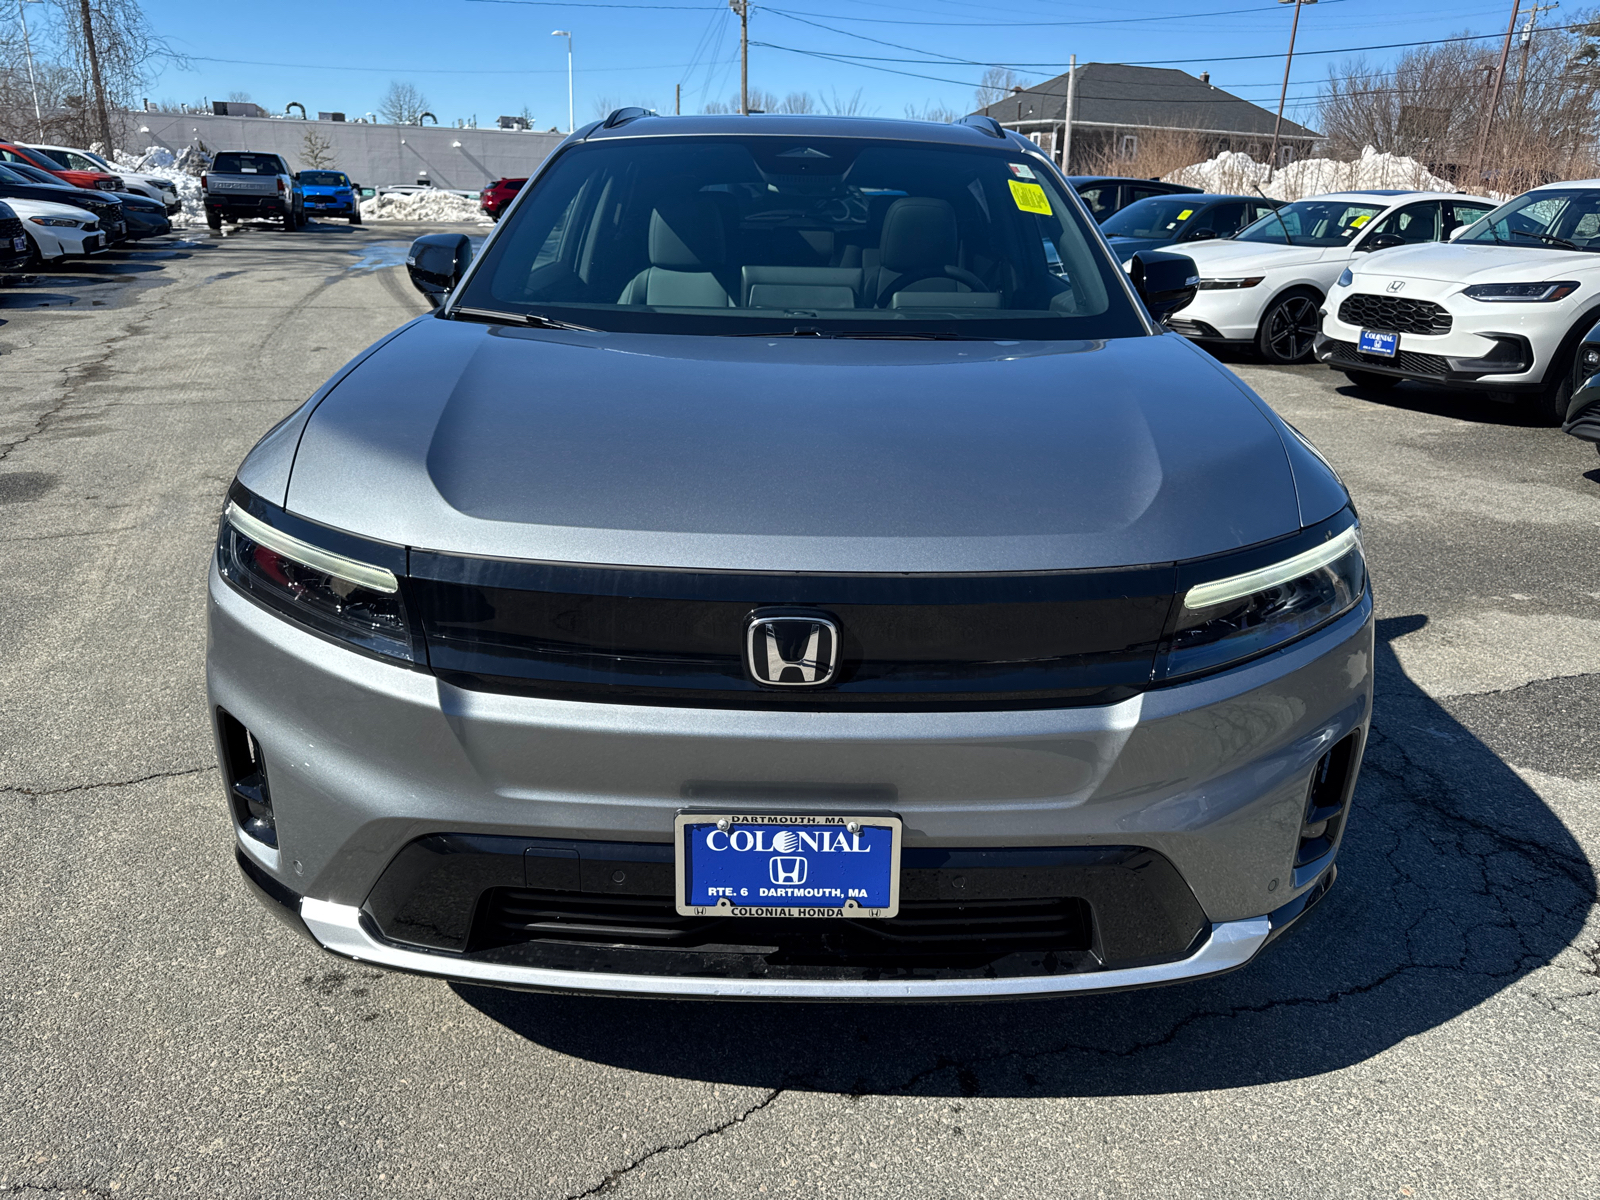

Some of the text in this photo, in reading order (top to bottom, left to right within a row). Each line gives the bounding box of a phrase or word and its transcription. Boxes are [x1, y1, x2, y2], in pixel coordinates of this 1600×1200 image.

[731, 815, 820, 824] DARTMOUTH,
[706, 829, 871, 853] COLONIAL
[708, 887, 868, 899] RTE. 6 DARTMOUTH, MA
[731, 907, 844, 917] COLONIAL HONDA
